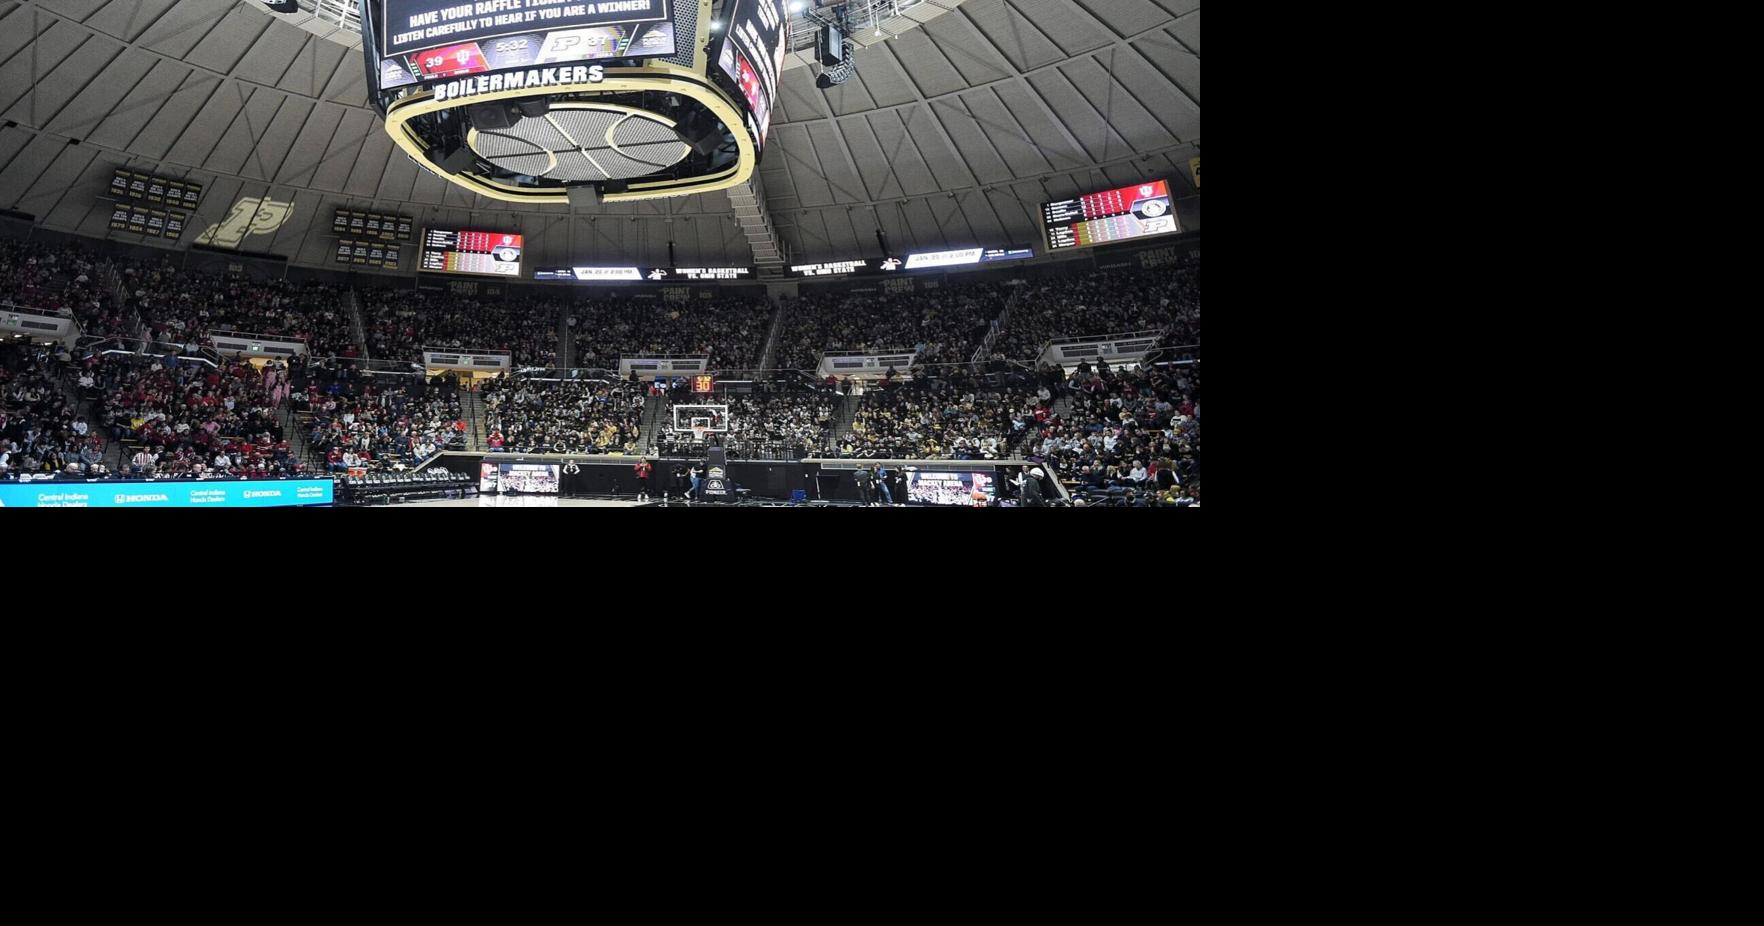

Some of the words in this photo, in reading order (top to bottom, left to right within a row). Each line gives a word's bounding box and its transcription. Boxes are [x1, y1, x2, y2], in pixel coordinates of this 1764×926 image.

[410, 11, 438, 28] HAVE
[440, 4, 472, 21] YOUR
[475, 0, 521, 14] RAFFLE
[393, 29, 425, 45] LISTEN
[426, 19, 477, 38] CAREFULLY
[478, 16, 493, 28] TO
[495, 12, 522, 26] HEAR
[524, 10, 537, 21] IF
[538, 7, 561, 20] YOU
[563, 5, 585, 17] ARE
[587, 4, 596, 14] A
[597, 0, 650, 13] WINNER!
[496, 39, 528, 53] 5:32
[426, 56, 443, 68] 39
[434, 65, 604, 101] BOILERMAKERS
[824, 260, 867, 269] BASKETBALL
[696, 381, 710, 391] 30
[126, 494, 169, 503] HONDA
[251, 490, 281, 498] HONDA
